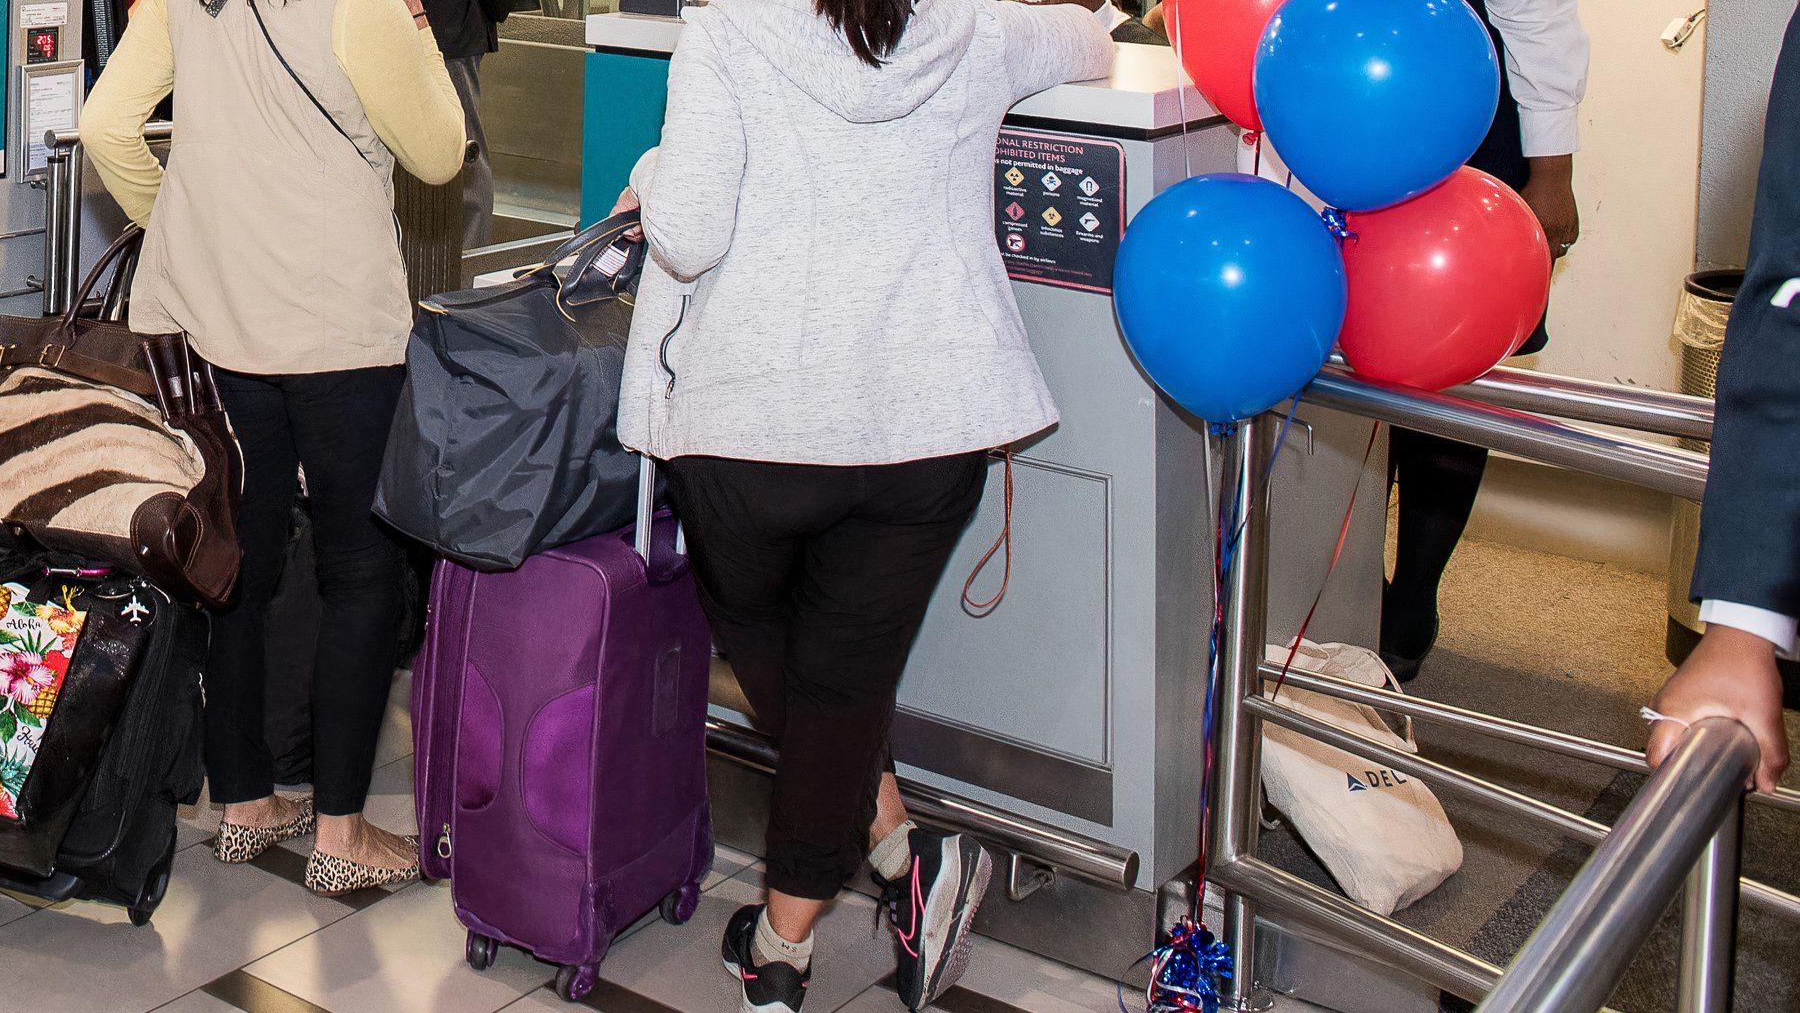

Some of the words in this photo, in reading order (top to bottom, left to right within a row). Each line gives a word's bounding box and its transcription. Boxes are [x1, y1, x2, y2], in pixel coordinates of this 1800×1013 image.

[1022, 140, 1084, 155] RESTRICTION
[1038, 153, 1066, 163] ITEMS
[1013, 160, 1046, 170] permitted
[1055, 165, 1084, 176] baggage
[6, 618, 42, 631] Aloha
[1364, 770, 1407, 788] DEL
